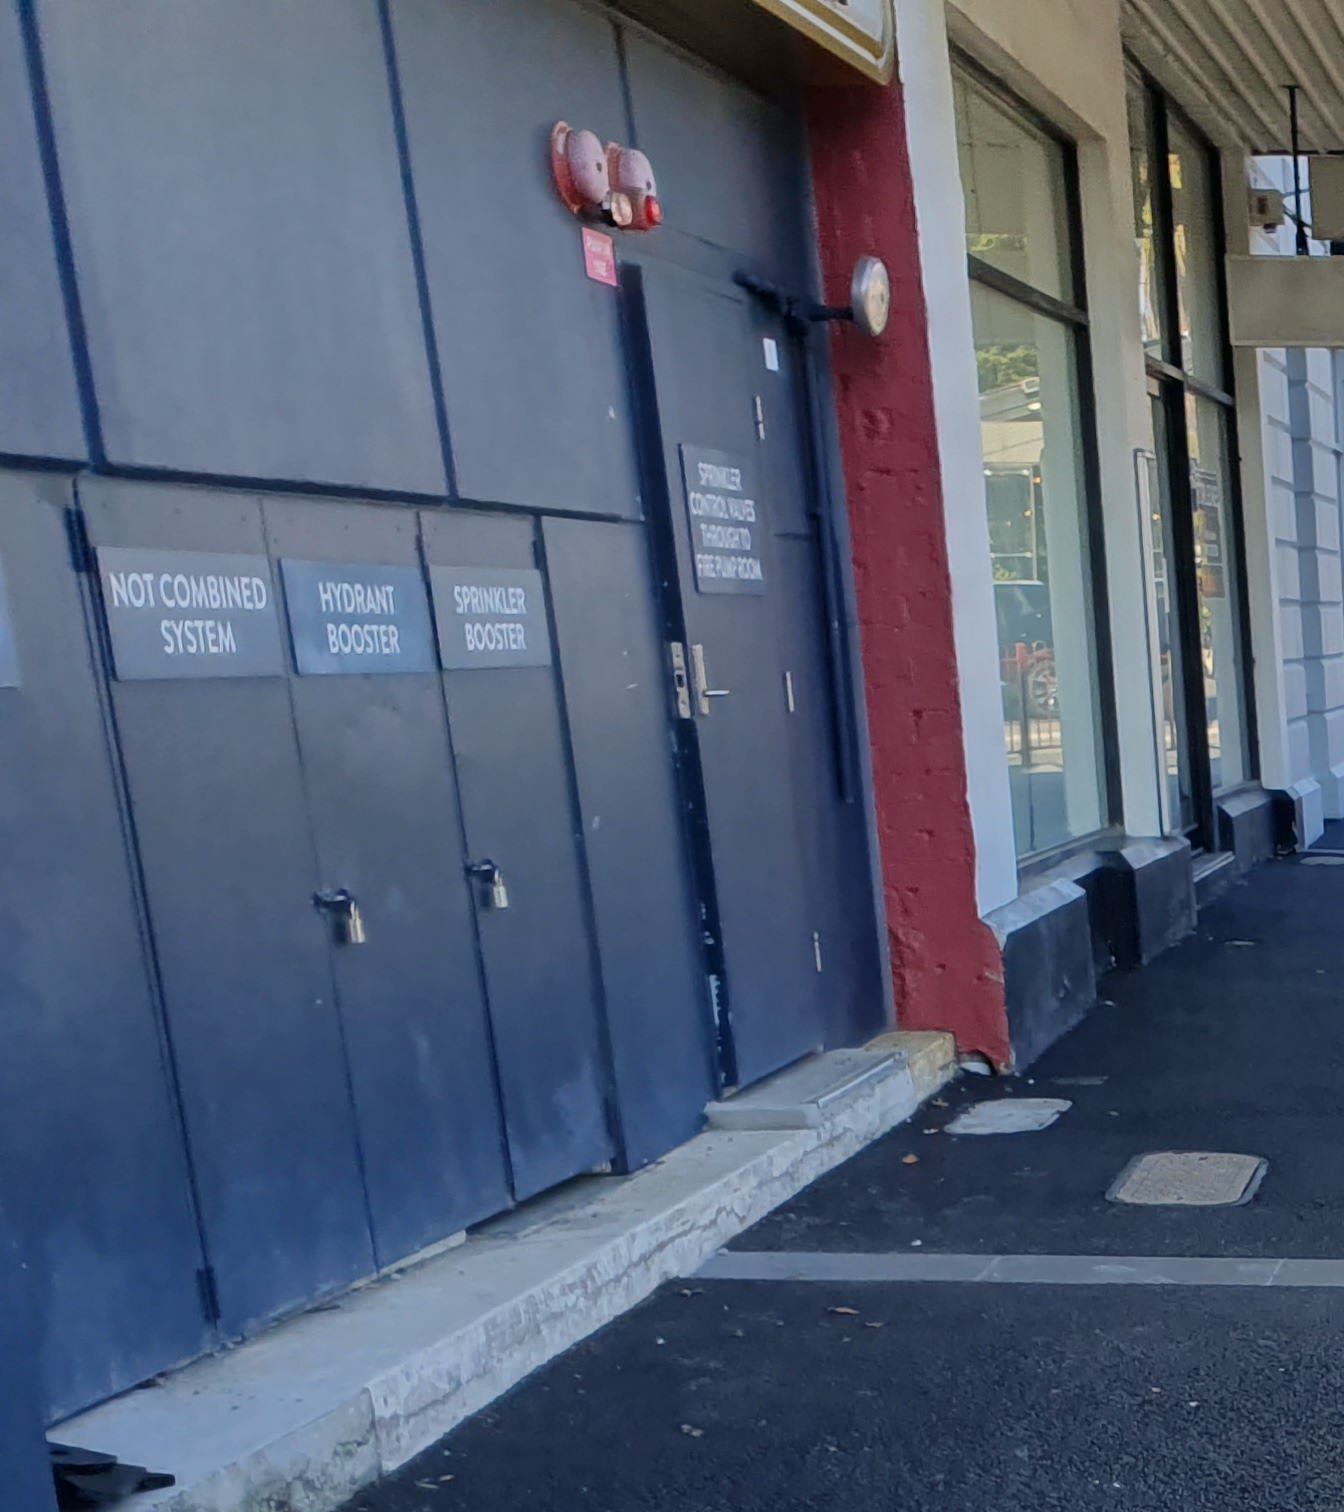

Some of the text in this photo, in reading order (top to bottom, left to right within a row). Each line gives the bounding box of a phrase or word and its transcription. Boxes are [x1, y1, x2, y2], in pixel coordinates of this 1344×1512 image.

[109, 572, 268, 611] NOT COMBINED
[317, 580, 396, 616] HYDRANT
[453, 584, 528, 615] SPRINKLER
[160, 619, 238, 655] SYSTEM
[326, 622, 401, 656] BOOSTER
[464, 621, 527, 652] BOOSTER
